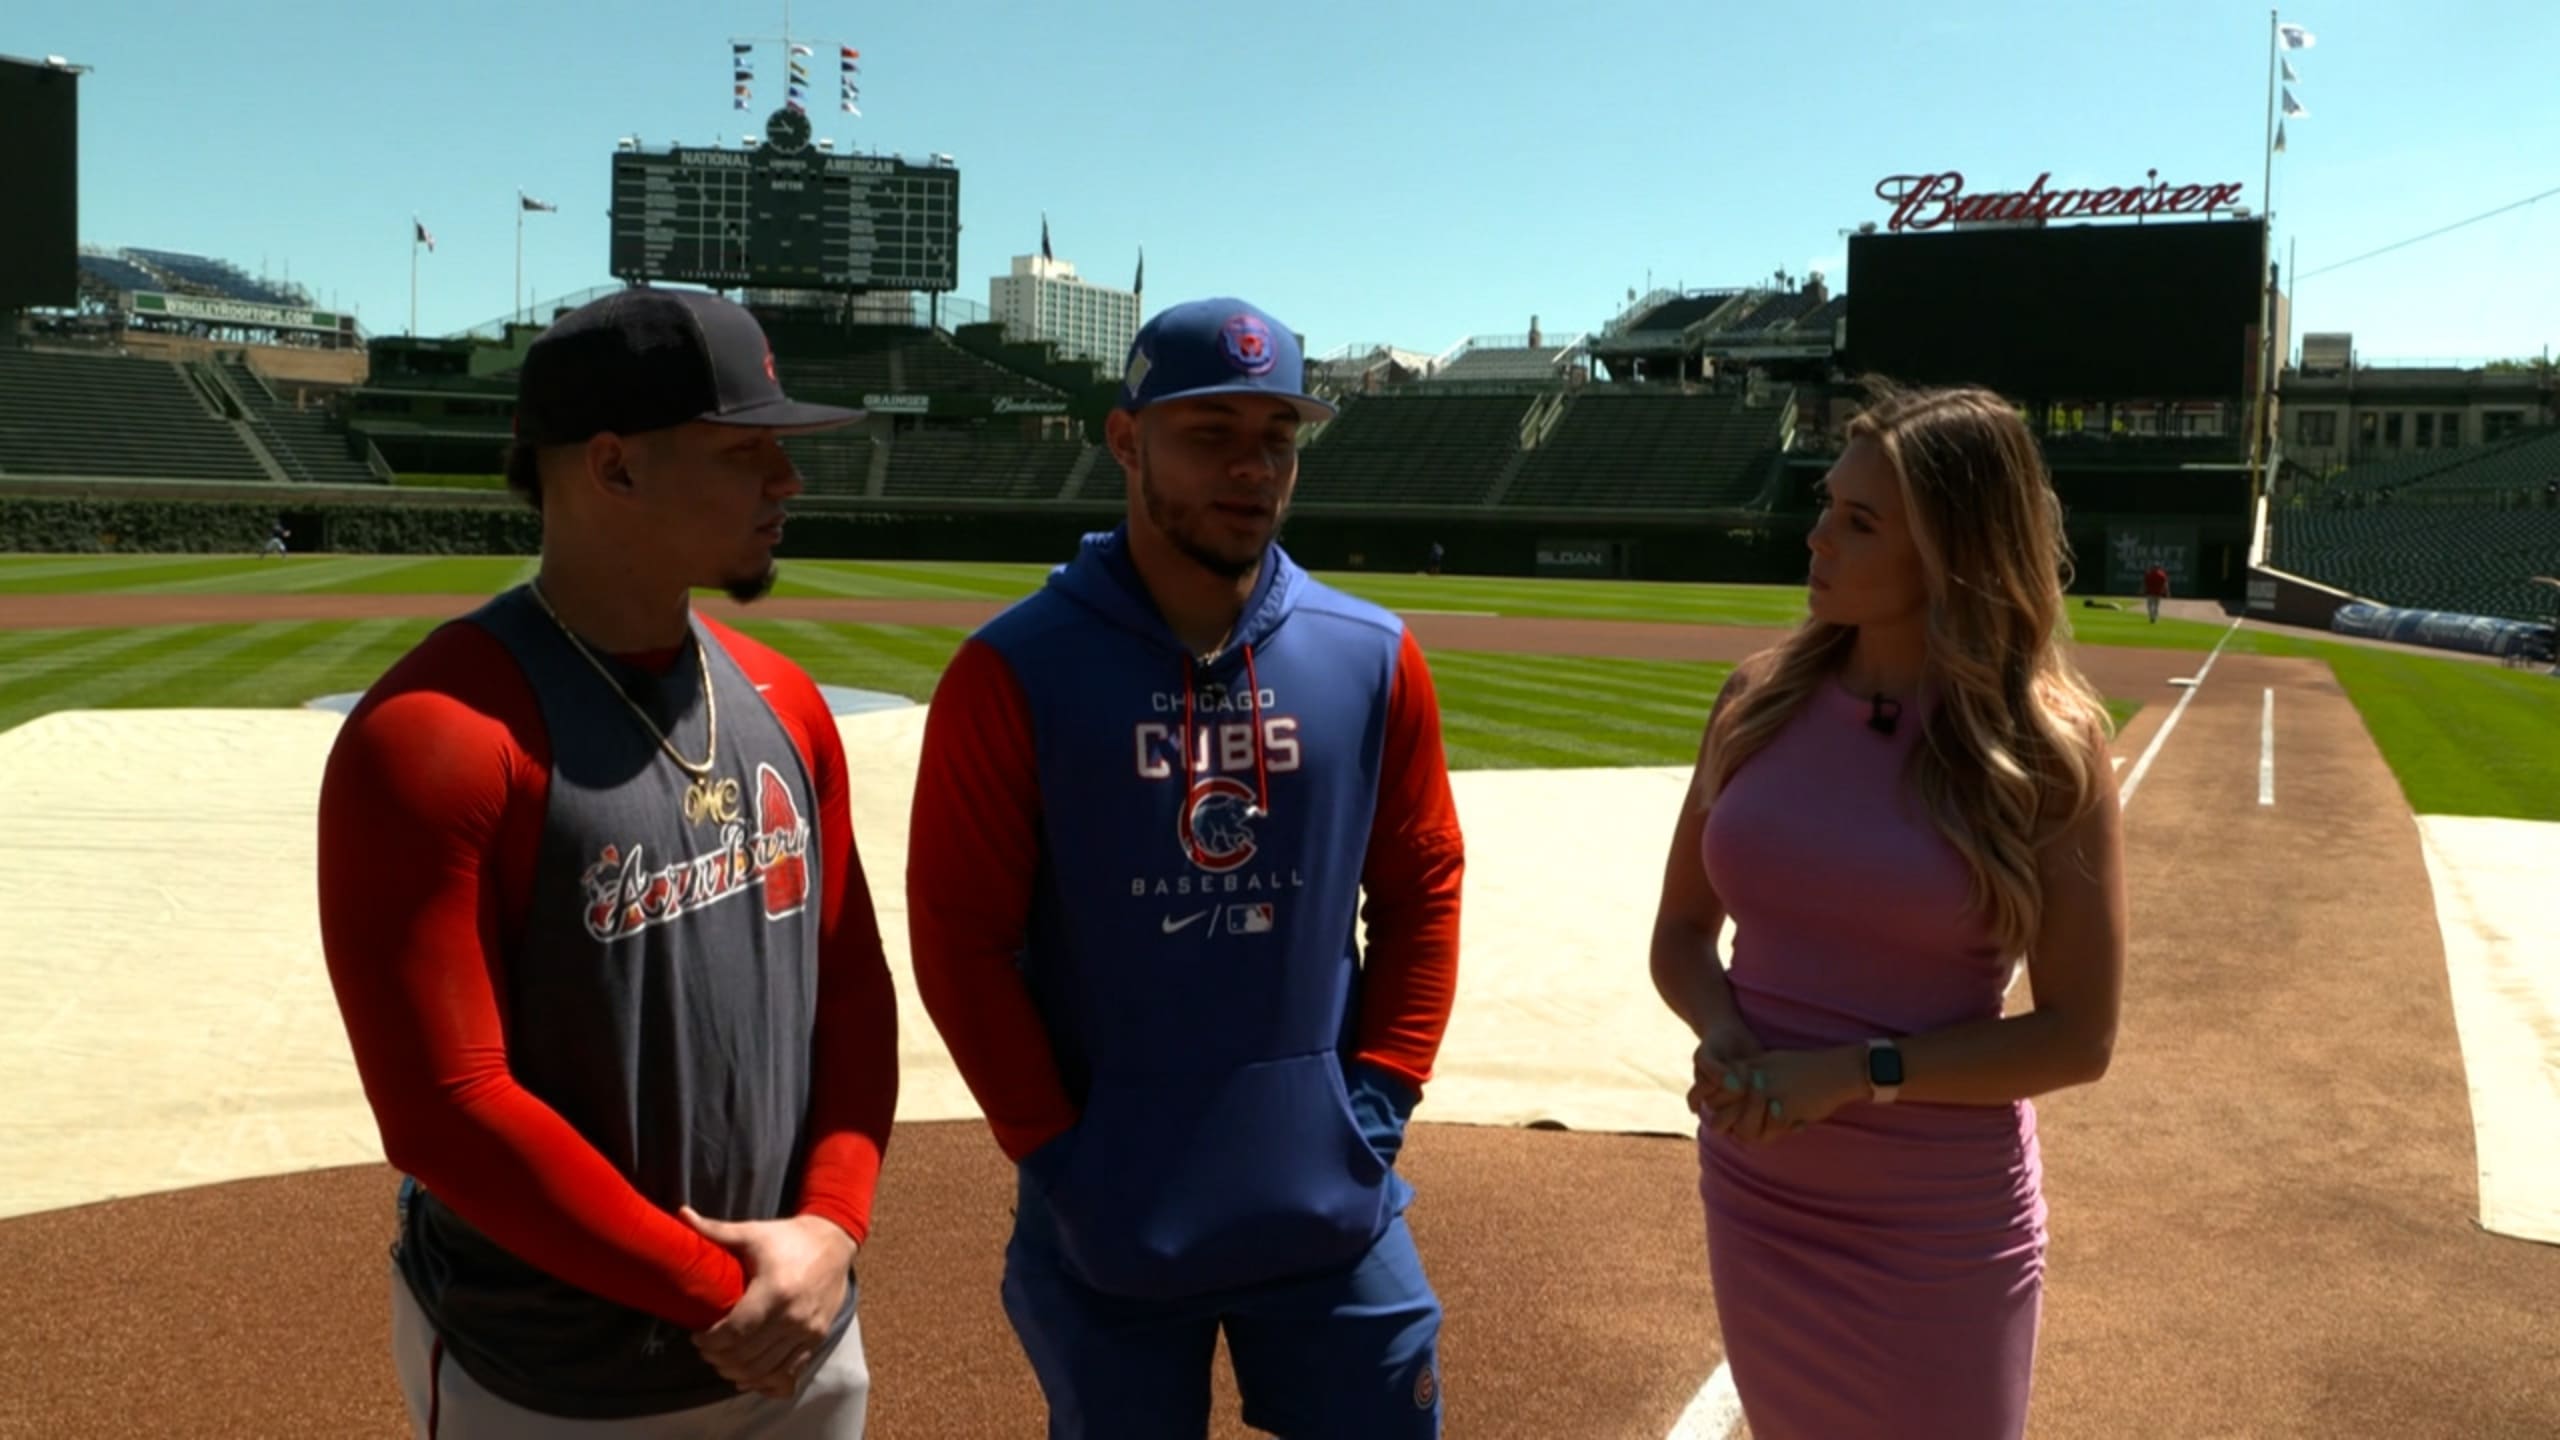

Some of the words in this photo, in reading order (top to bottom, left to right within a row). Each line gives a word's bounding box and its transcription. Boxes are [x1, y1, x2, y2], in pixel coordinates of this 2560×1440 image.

[681, 151, 752, 167] NATIONAL
[824, 159, 894, 175] AMERICAN
[1875, 168, 2244, 232] Budweiser
[165, 296, 314, 326] WRIGLEYROOFTOPS.COM
[992, 395, 1068, 414] Budweiser
[1537, 550, 1602, 566] SLOAN
[1134, 716, 1301, 779] CUBS
[1131, 867, 1304, 897] BASEBALL
